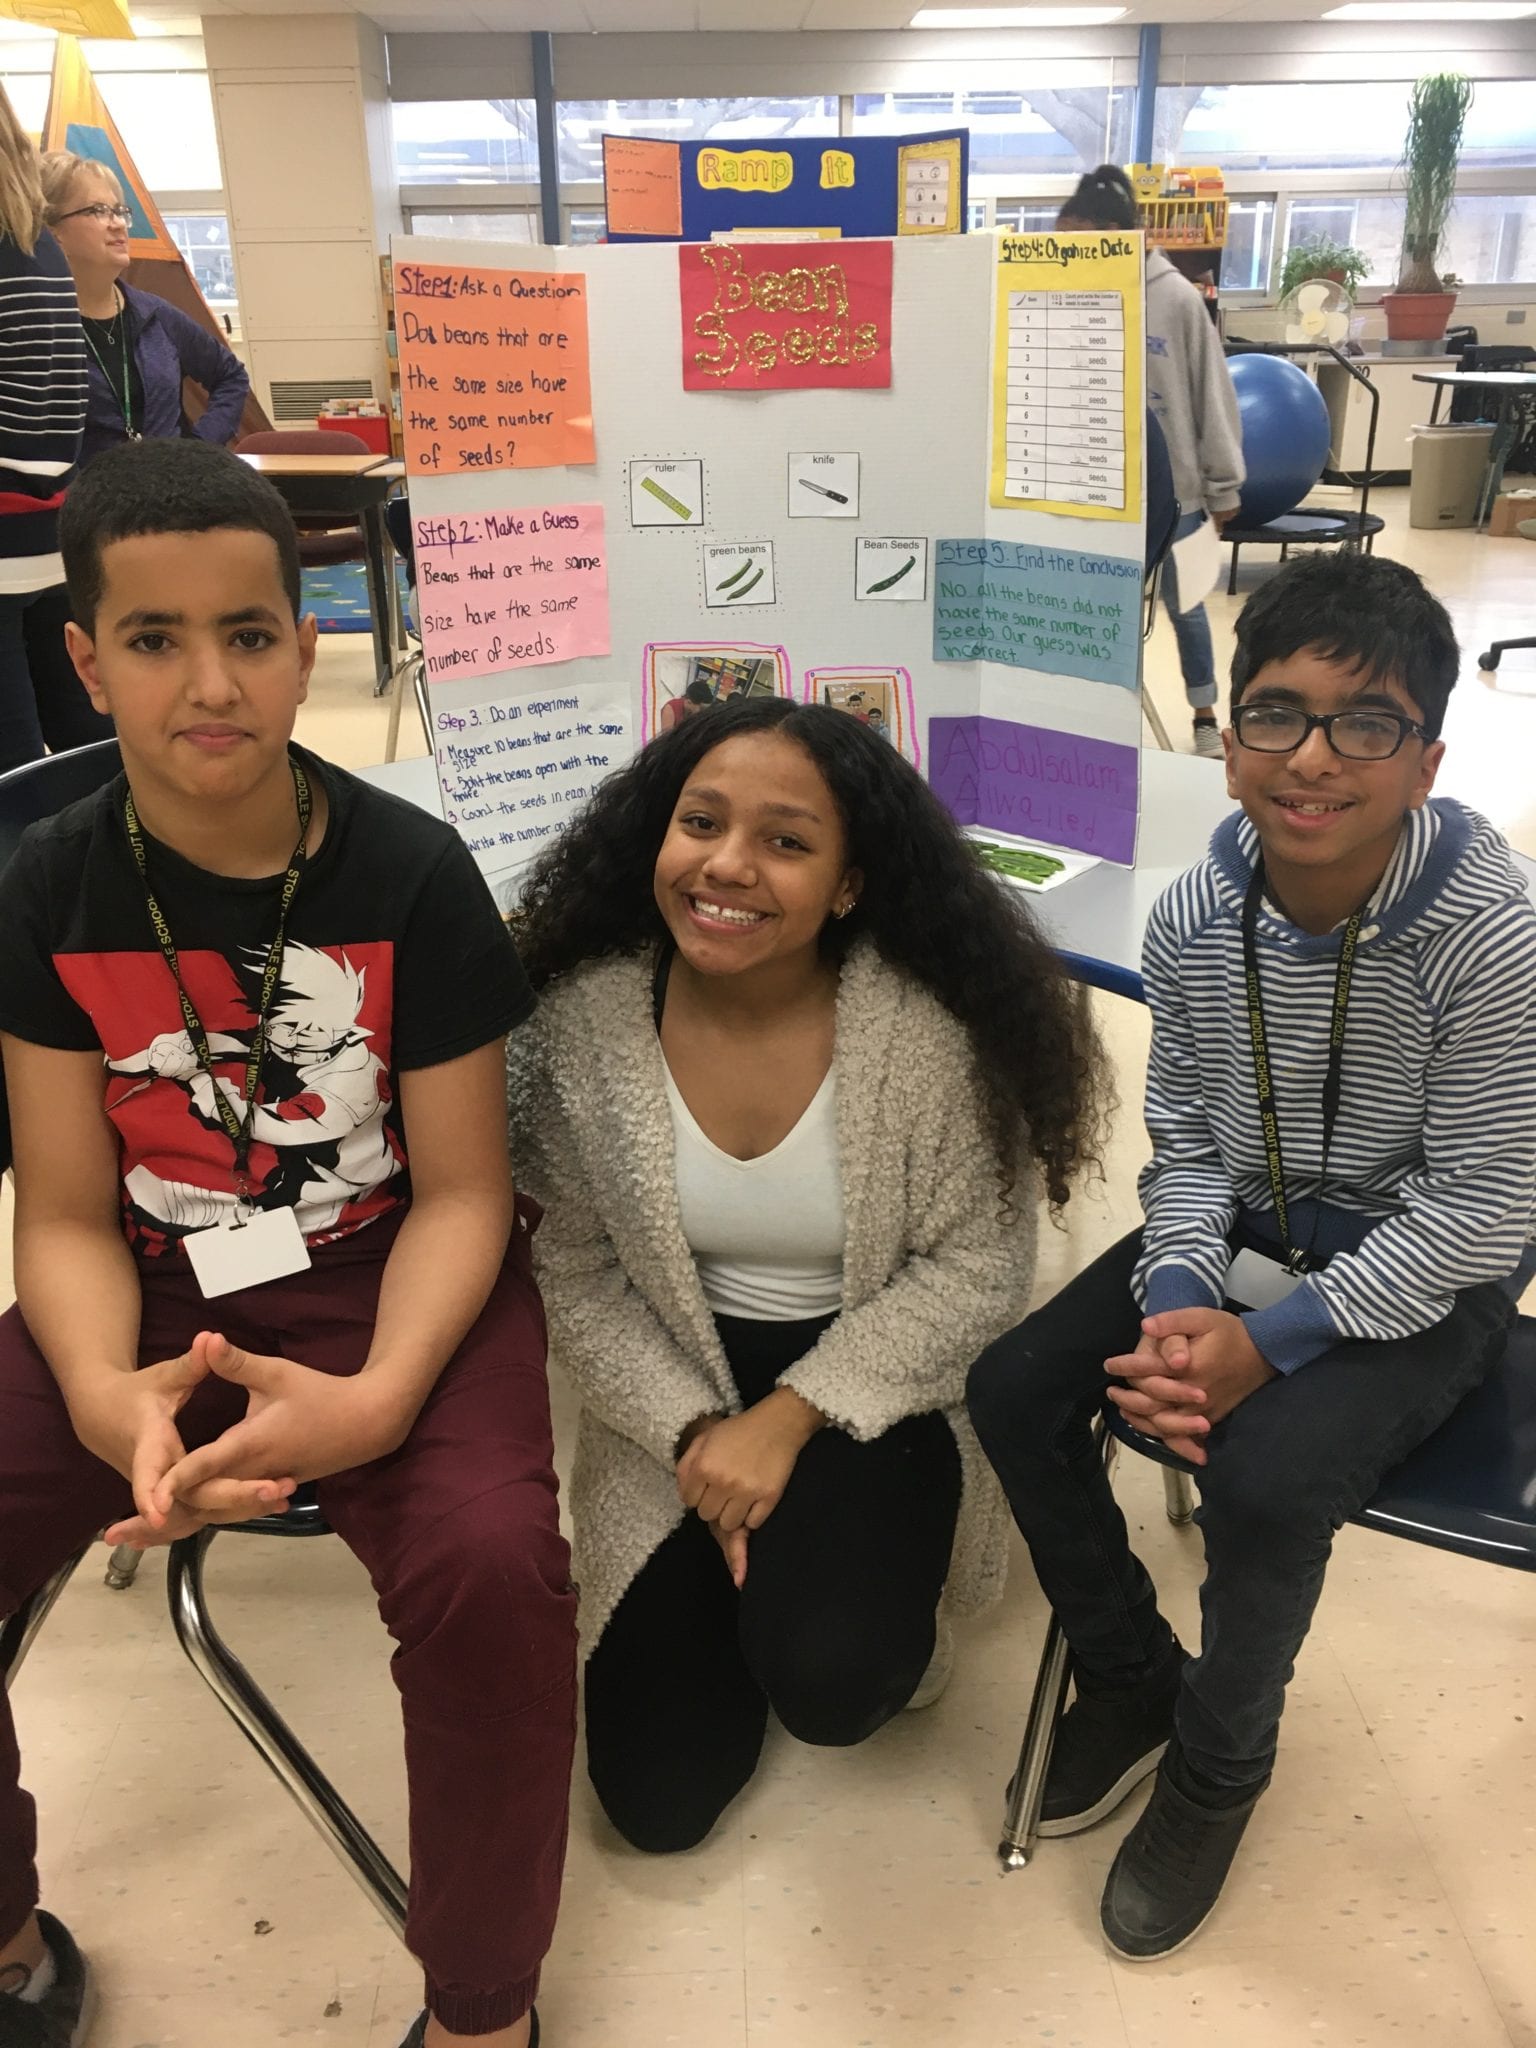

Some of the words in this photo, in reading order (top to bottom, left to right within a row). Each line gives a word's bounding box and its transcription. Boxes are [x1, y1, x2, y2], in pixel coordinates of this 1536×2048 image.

[702, 153, 790, 189] Ramp
[826, 155, 849, 184] It
[1046, 238, 1098, 266] Organize
[1101, 238, 1133, 258] Data
[460, 275, 487, 295] Ask
[494, 286, 501, 297] a
[510, 279, 580, 298] Question
[700, 243, 848, 313] Bean
[444, 323, 489, 345] beans
[497, 327, 529, 347] that
[539, 332, 568, 349] are
[695, 314, 879, 376] Seeds
[1026, 354, 1030, 362] 3
[1089, 357, 1107, 365] seeds
[407, 363, 439, 391] the
[453, 376, 486, 394] same
[496, 379, 523, 393] size
[532, 370, 567, 392] have
[1089, 376, 1107, 385] seeds
[1025, 392, 1028, 400] 5
[1089, 396, 1107, 404] seeds
[409, 411, 438, 431] the
[449, 414, 489, 431] same
[498, 410, 553, 425] number
[1089, 416, 1107, 424] seeds
[420, 443, 441, 468] of
[459, 441, 515, 465] seeds?
[1089, 436, 1107, 444] seeds
[655, 464, 676, 473] ruler
[812, 455, 835, 465] knife
[1089, 455, 1108, 463] seeds
[1089, 474, 1107, 482] seeds
[1088, 493, 1106, 501] seeds
[418, 519, 456, 559] Step
[485, 516, 525, 540] Make
[530, 520, 540, 532] a
[543, 510, 579, 530] Guess
[710, 546, 736, 557] green
[738, 545, 766, 554] beans
[864, 540, 888, 549] Bean
[891, 540, 919, 550] Seeds
[421, 562, 459, 585] Beans
[468, 563, 495, 580] that
[504, 564, 522, 578] are
[530, 555, 553, 572] the
[565, 557, 601, 571] same
[941, 542, 987, 564] Step
[1016, 546, 1045, 569] Find
[1048, 554, 1074, 572] the
[1080, 558, 1140, 580] Conclusion
[425, 610, 454, 633] size
[465, 603, 496, 624] have
[506, 599, 531, 618] the
[541, 596, 578, 614] same
[940, 582, 967, 597] No
[978, 583, 997, 597] all
[1000, 586, 1023, 601] the
[1027, 588, 1068, 609] beans
[1073, 597, 1093, 615] did
[1098, 603, 1122, 617] not
[938, 607, 980, 619] have
[985, 606, 1008, 621] the
[1013, 614, 1045, 629] same
[1103, 624, 1121, 641] of
[428, 649, 478, 672] number
[488, 636, 502, 662] of
[1002, 626, 1029, 644] Our
[1033, 635, 1075, 656] guess
[1079, 644, 1111, 660] was
[438, 713, 466, 733] Step
[490, 705, 505, 722] Do
[509, 707, 522, 720] an
[528, 696, 579, 717] experiment
[448, 743, 495, 759] Measure
[496, 741, 506, 752] 10
[508, 736, 531, 750] beans
[533, 731, 550, 744] that
[556, 728, 571, 740] are
[576, 722, 593, 735] the
[599, 724, 623, 734] same
[453, 754, 478, 772] size
[457, 775, 484, 790] Split
[483, 771, 502, 785] the
[506, 765, 532, 780] beans
[536, 762, 557, 779] open
[560, 755, 581, 770] with
[586, 754, 608, 766] the
[939, 723, 1120, 794] Abdulsalam
[295, 769, 310, 813] MIDDLE
[461, 804, 493, 821] Count
[497, 802, 515, 815] the
[520, 793, 547, 808] seeds
[552, 792, 562, 804] in
[566, 785, 587, 801] each
[499, 832, 519, 845] the
[517, 824, 551, 841] number
[555, 822, 565, 832] on
[282, 869, 299, 909] STOUT
[148, 894, 172, 945] SCHOOL
[1342, 912, 1362, 961] SCHOOL
[1248, 971, 1259, 1007] STOUT
[1337, 964, 1351, 1007] MIDDLE
[1249, 1011, 1264, 1052] MIDDLE
[1332, 1009, 1346, 1047] STOUT
[247, 1065, 258, 1097] MIDD
[1255, 1055, 1271, 1100] SCHOOL
[217, 1096, 240, 1138] MIDDLE
[1263, 1112, 1277, 1149] STOUT
[1268, 1150, 1282, 1192] MIDDLE
[1276, 1195, 1288, 1240] SCHOOL
